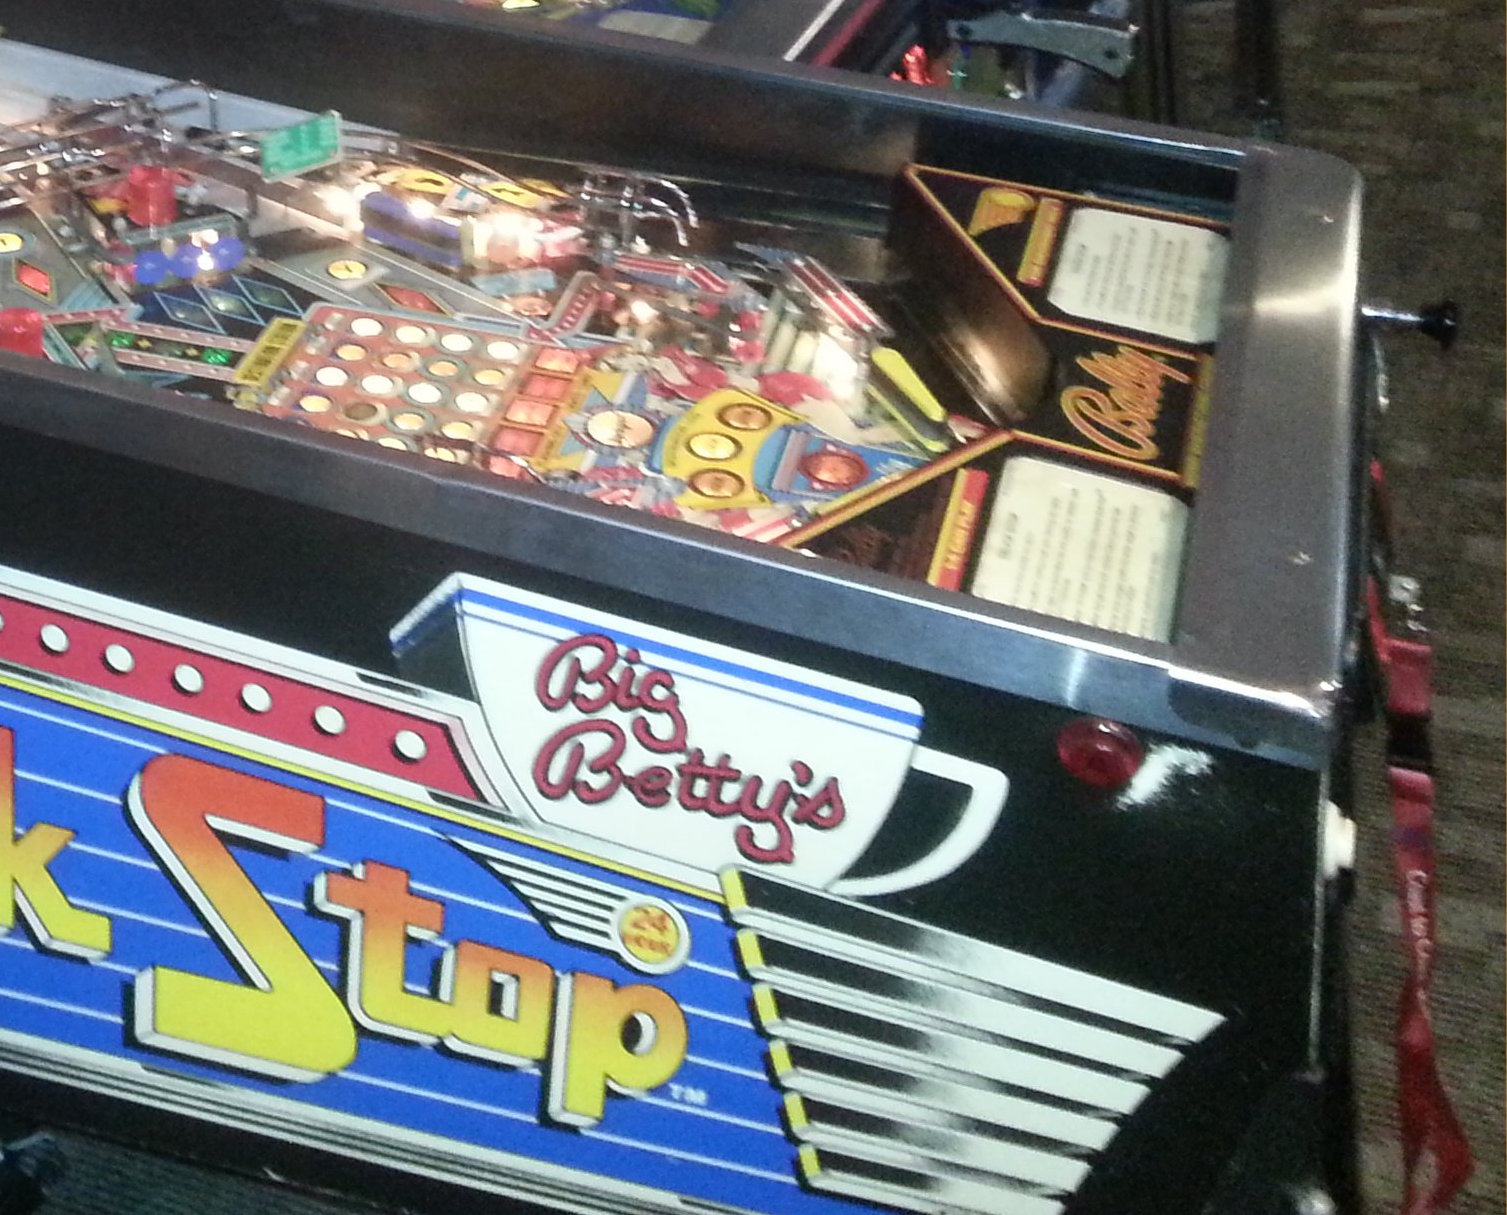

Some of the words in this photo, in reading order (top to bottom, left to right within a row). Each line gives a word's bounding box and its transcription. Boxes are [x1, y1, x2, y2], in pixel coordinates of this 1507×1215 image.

[535, 632, 689, 754] Big
[532, 718, 847, 864] Betty's
[127, 752, 689, 1128] Stop
